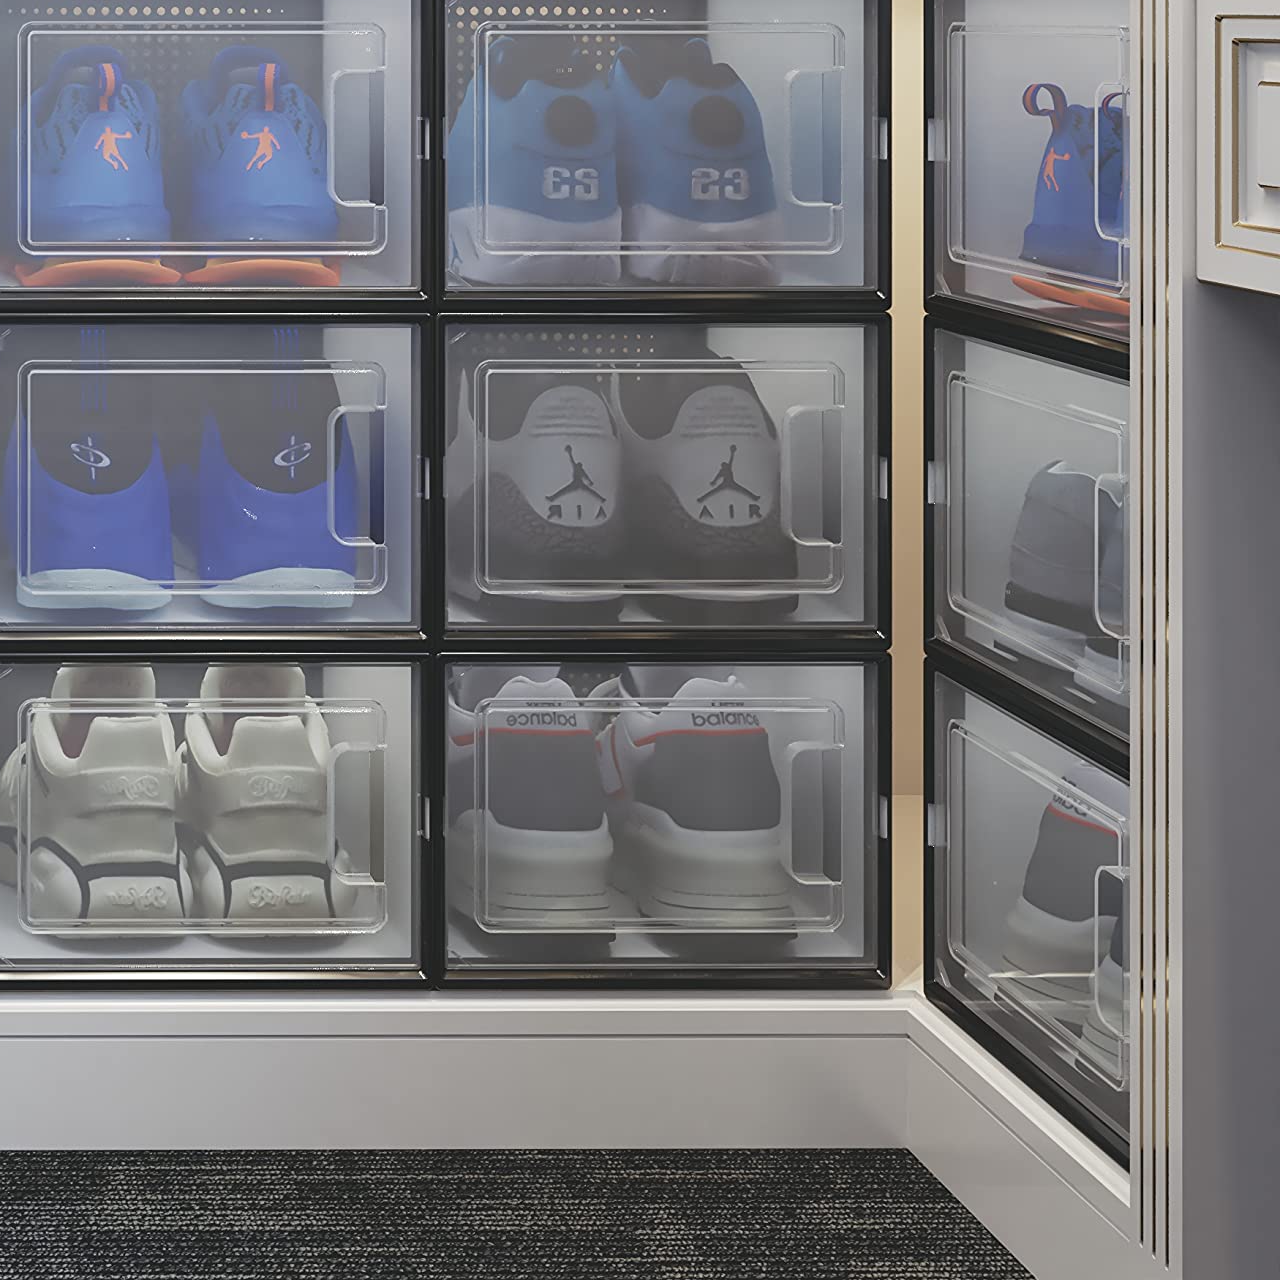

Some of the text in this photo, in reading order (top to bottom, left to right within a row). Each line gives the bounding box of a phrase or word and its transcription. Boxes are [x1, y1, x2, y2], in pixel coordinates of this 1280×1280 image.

[690, 167, 751, 201] 23
[699, 504, 762, 519] AIR
[691, 711, 760, 727] balance
